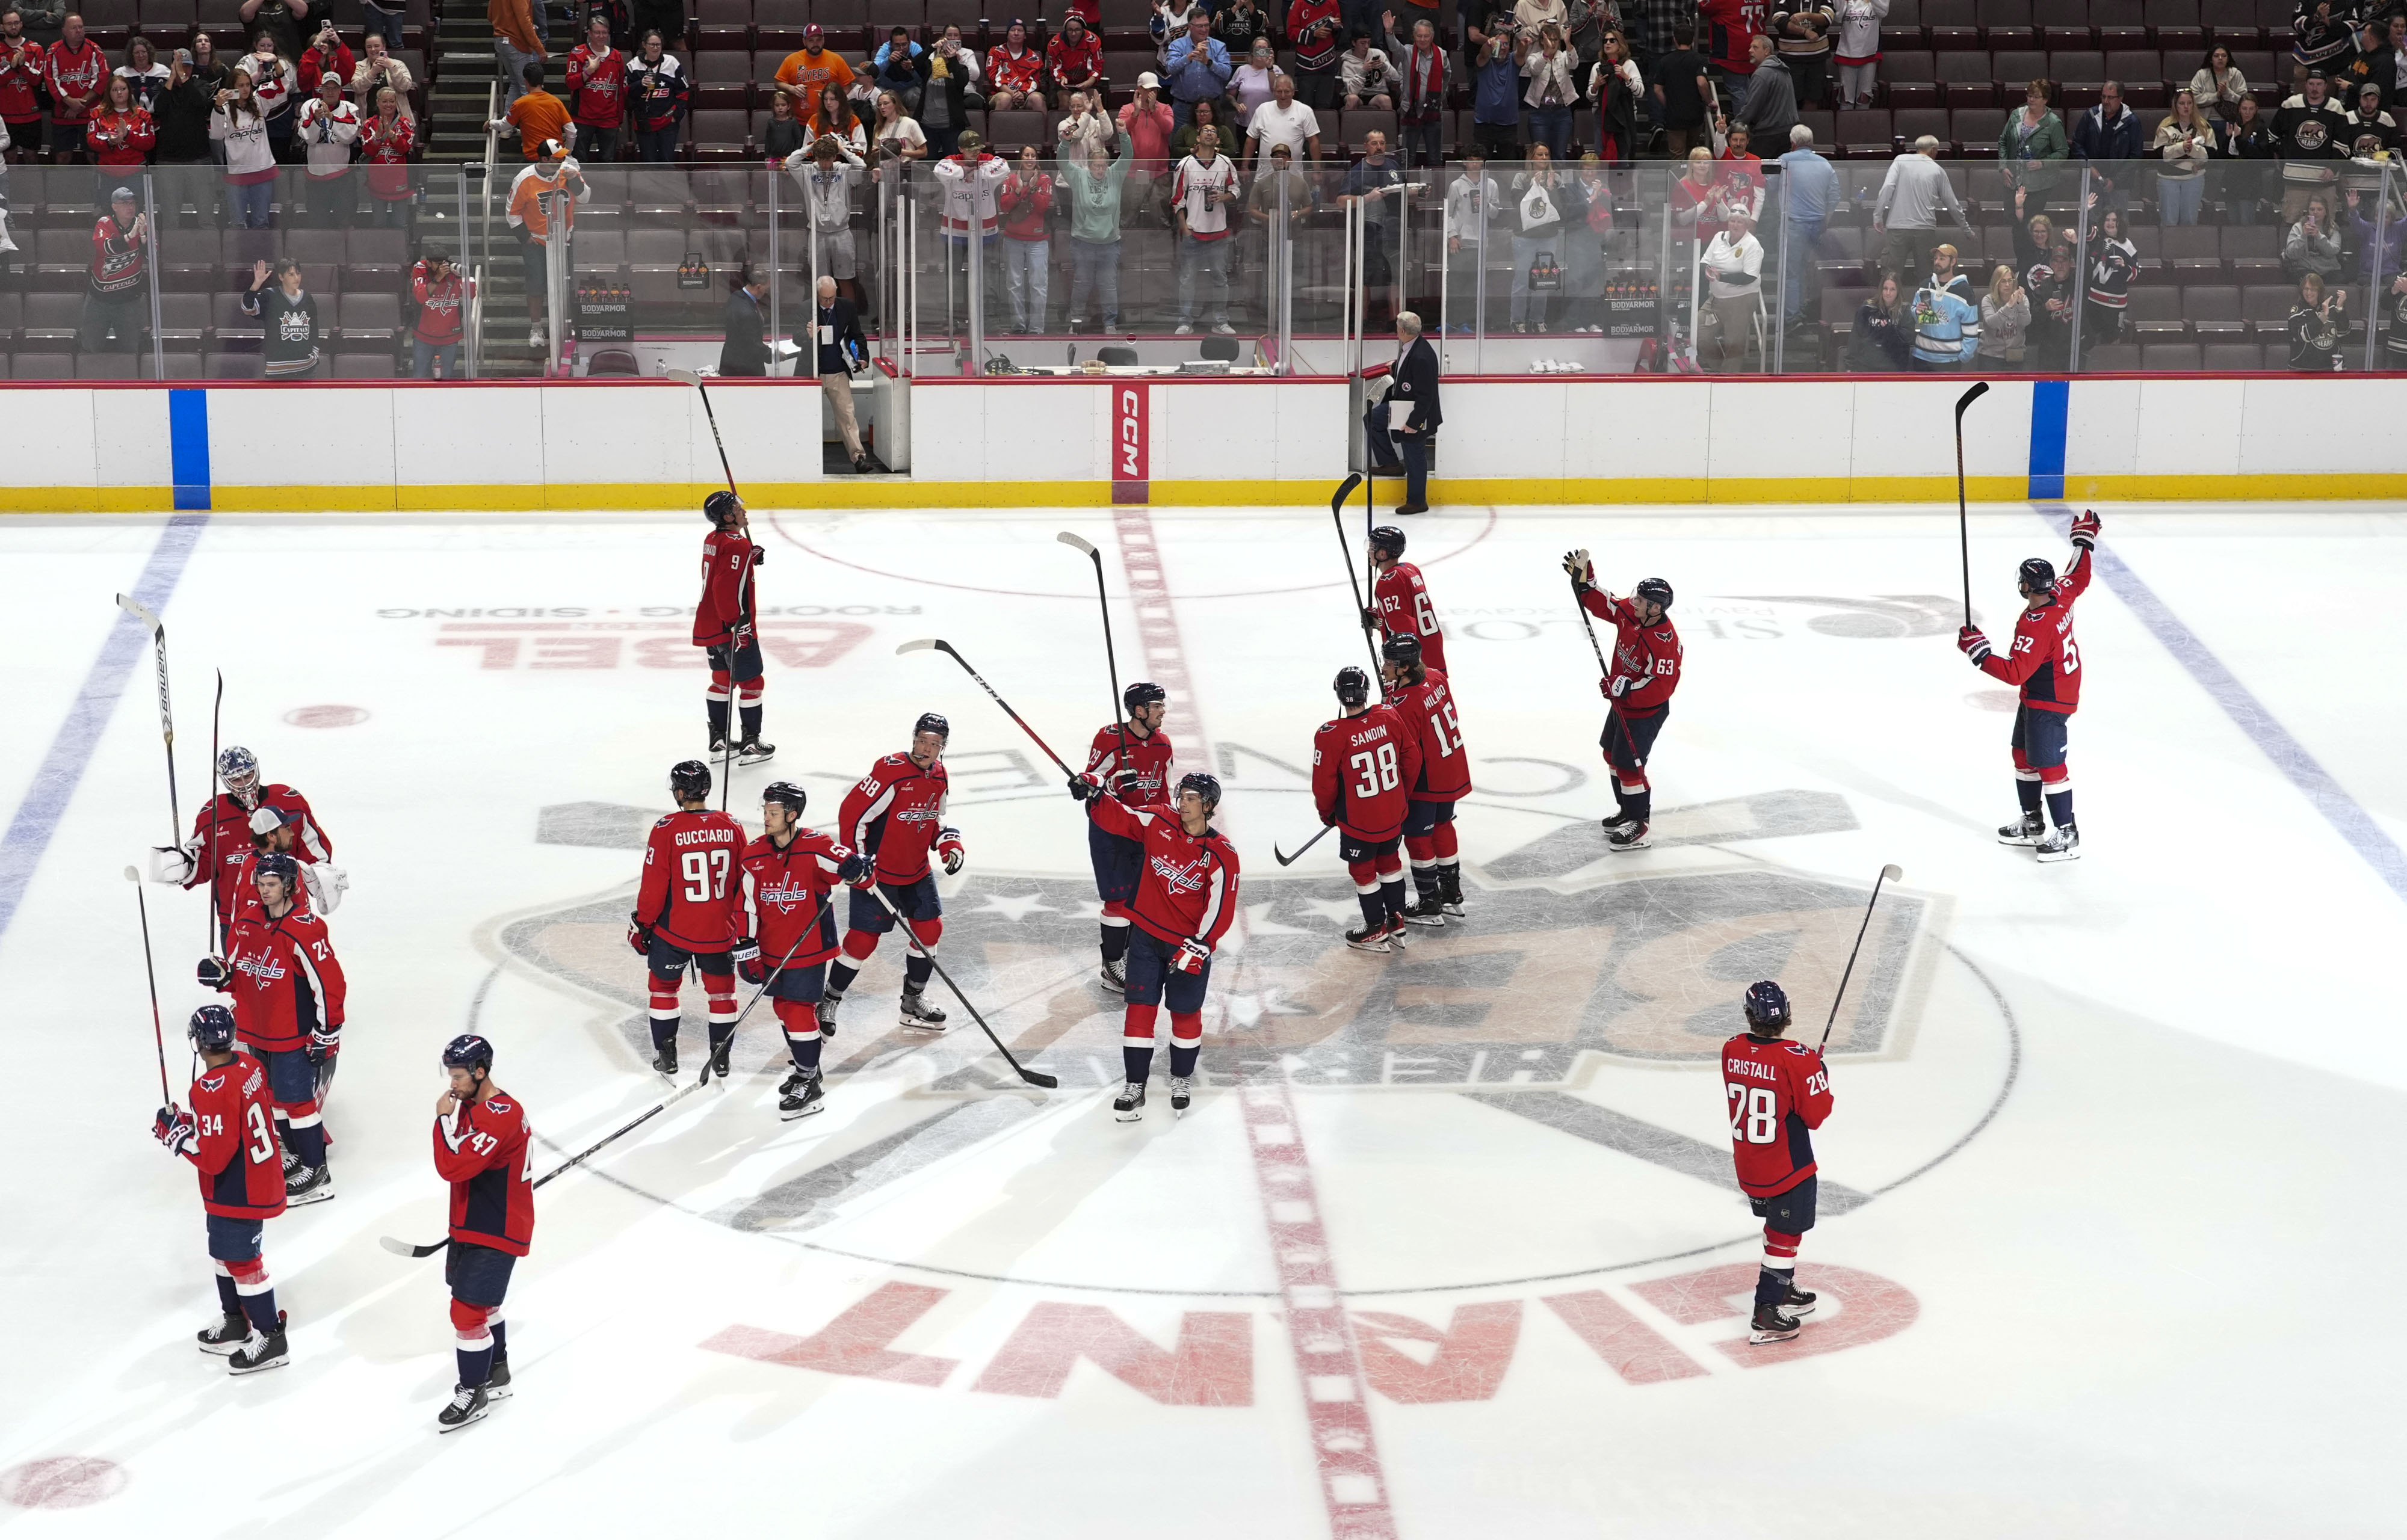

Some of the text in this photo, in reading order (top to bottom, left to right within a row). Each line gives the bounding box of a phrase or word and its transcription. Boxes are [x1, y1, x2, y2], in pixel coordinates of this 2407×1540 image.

[1740, 5, 1765, 33] 77
[568, 61, 578, 73] 13
[1312, 50, 1336, 67] CAPITA
[797, 67, 830, 83] FLYERS
[229, 122, 264, 143] capitals
[103, 277, 137, 291] CAPITALS
[1123, 390, 1138, 476] CCM
[731, 555, 741, 570] 9
[376, 604, 924, 620] ROOFG SIDING
[1383, 595, 1401, 613] 62
[1414, 592, 1439, 638] 6
[2013, 635, 2035, 654] 52
[2062, 628, 2079, 675] 5
[1657, 659, 1674, 676] 63
[1614, 675, 1626, 693] UER
[1423, 684, 1446, 710] MILANO
[1350, 724, 1387, 747] SANDIN
[1089, 748, 1101, 766] 29
[1312, 749, 1322, 766] 8
[1350, 741, 1400, 799] 38
[859, 774, 881, 798] 98
[897, 793, 939, 833] capitals
[675, 829, 734, 846] GUCCIARDI
[646, 846, 655, 865] 3
[1156, 855, 1181, 873] WASHINGTON
[1198, 851, 1211, 869] A
[681, 848, 731, 902] 93
[1150, 860, 1204, 895] capitals
[311, 938, 332, 962] 24
[732, 948, 759, 962] AUER
[235, 946, 286, 991] capitals
[1770, 1007, 1780, 1017] 28
[217, 1030, 227, 1039] 34
[1728, 1058, 1776, 1082] CRISTALL
[1806, 1070, 1828, 1097] 28
[1727, 1082, 1777, 1145] 28
[202, 1114, 224, 1136] 34
[247, 1101, 274, 1165] 3
[471, 1132, 498, 1157] 47
[520, 1135, 534, 1184] 4
[696, 1260, 1921, 1408] GIANT
